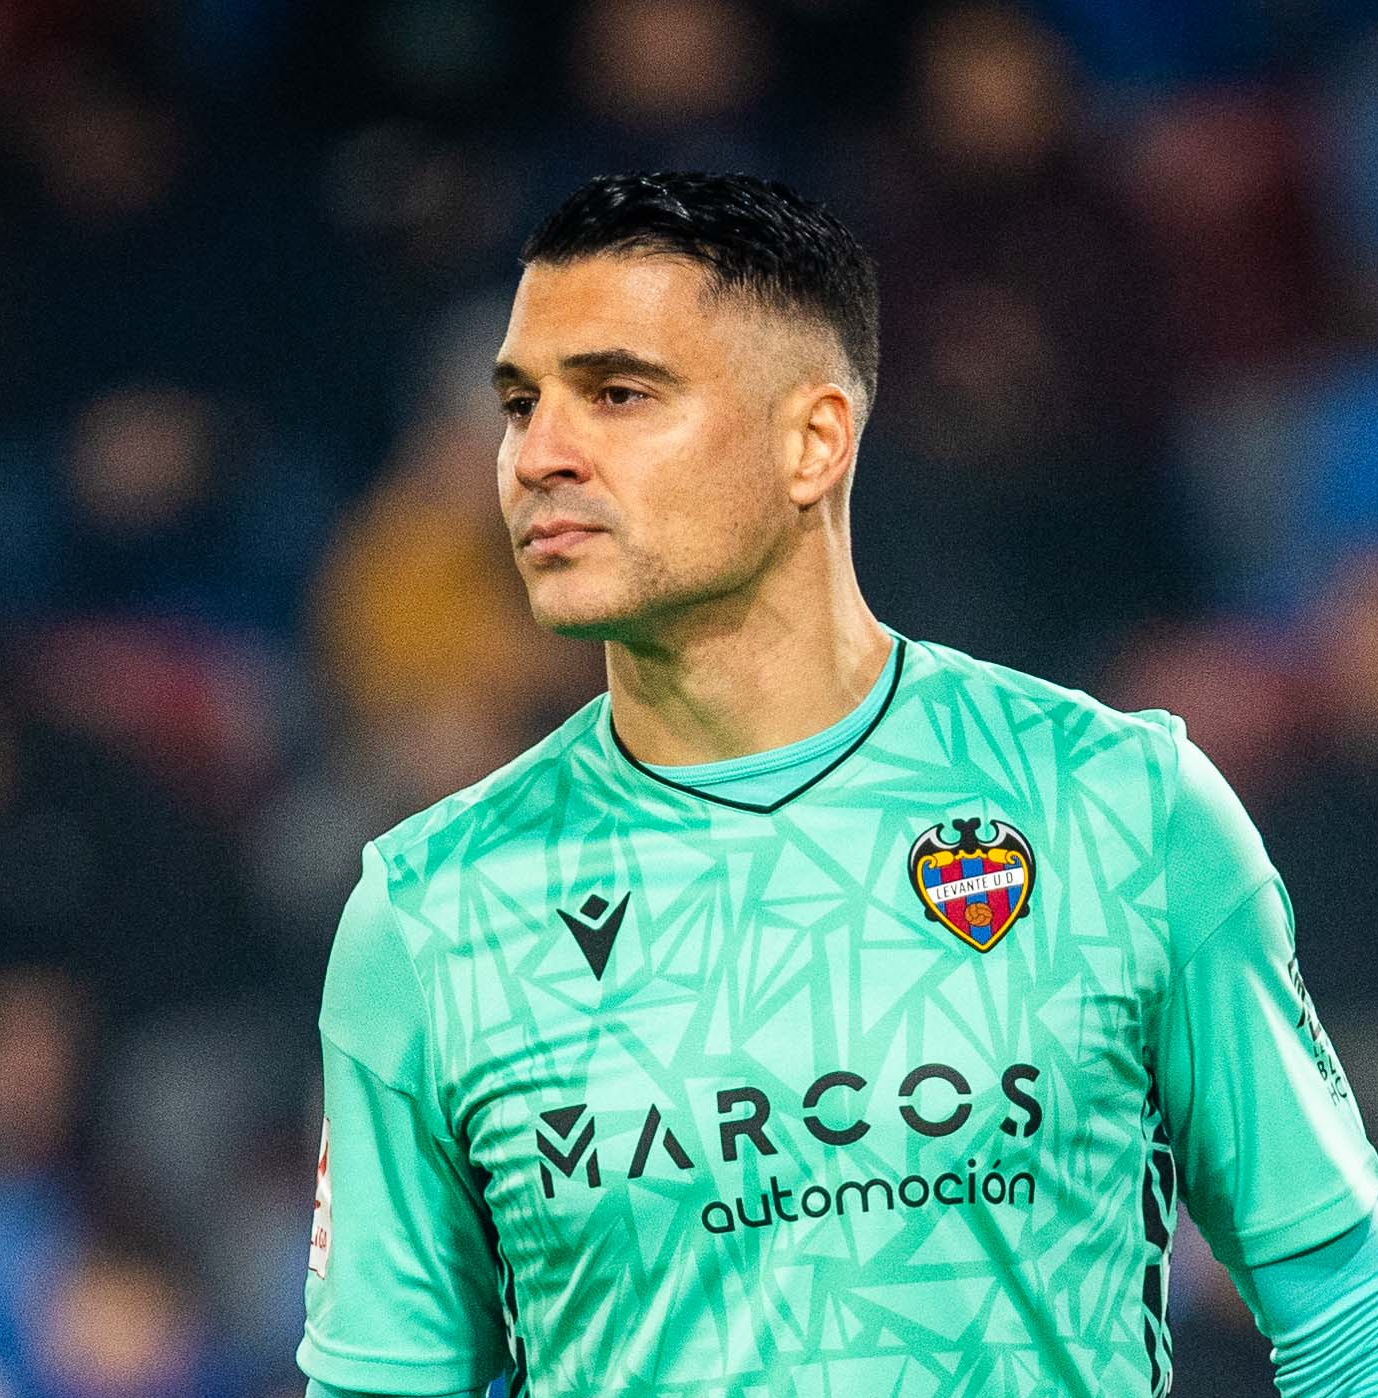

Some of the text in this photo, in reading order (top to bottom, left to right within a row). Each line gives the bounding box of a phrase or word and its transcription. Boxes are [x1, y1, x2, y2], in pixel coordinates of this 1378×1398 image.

[936, 876, 988, 900] LEVANTE
[536, 1063, 1044, 1199] MARCOS
[701, 1158, 1036, 1235] automoción
